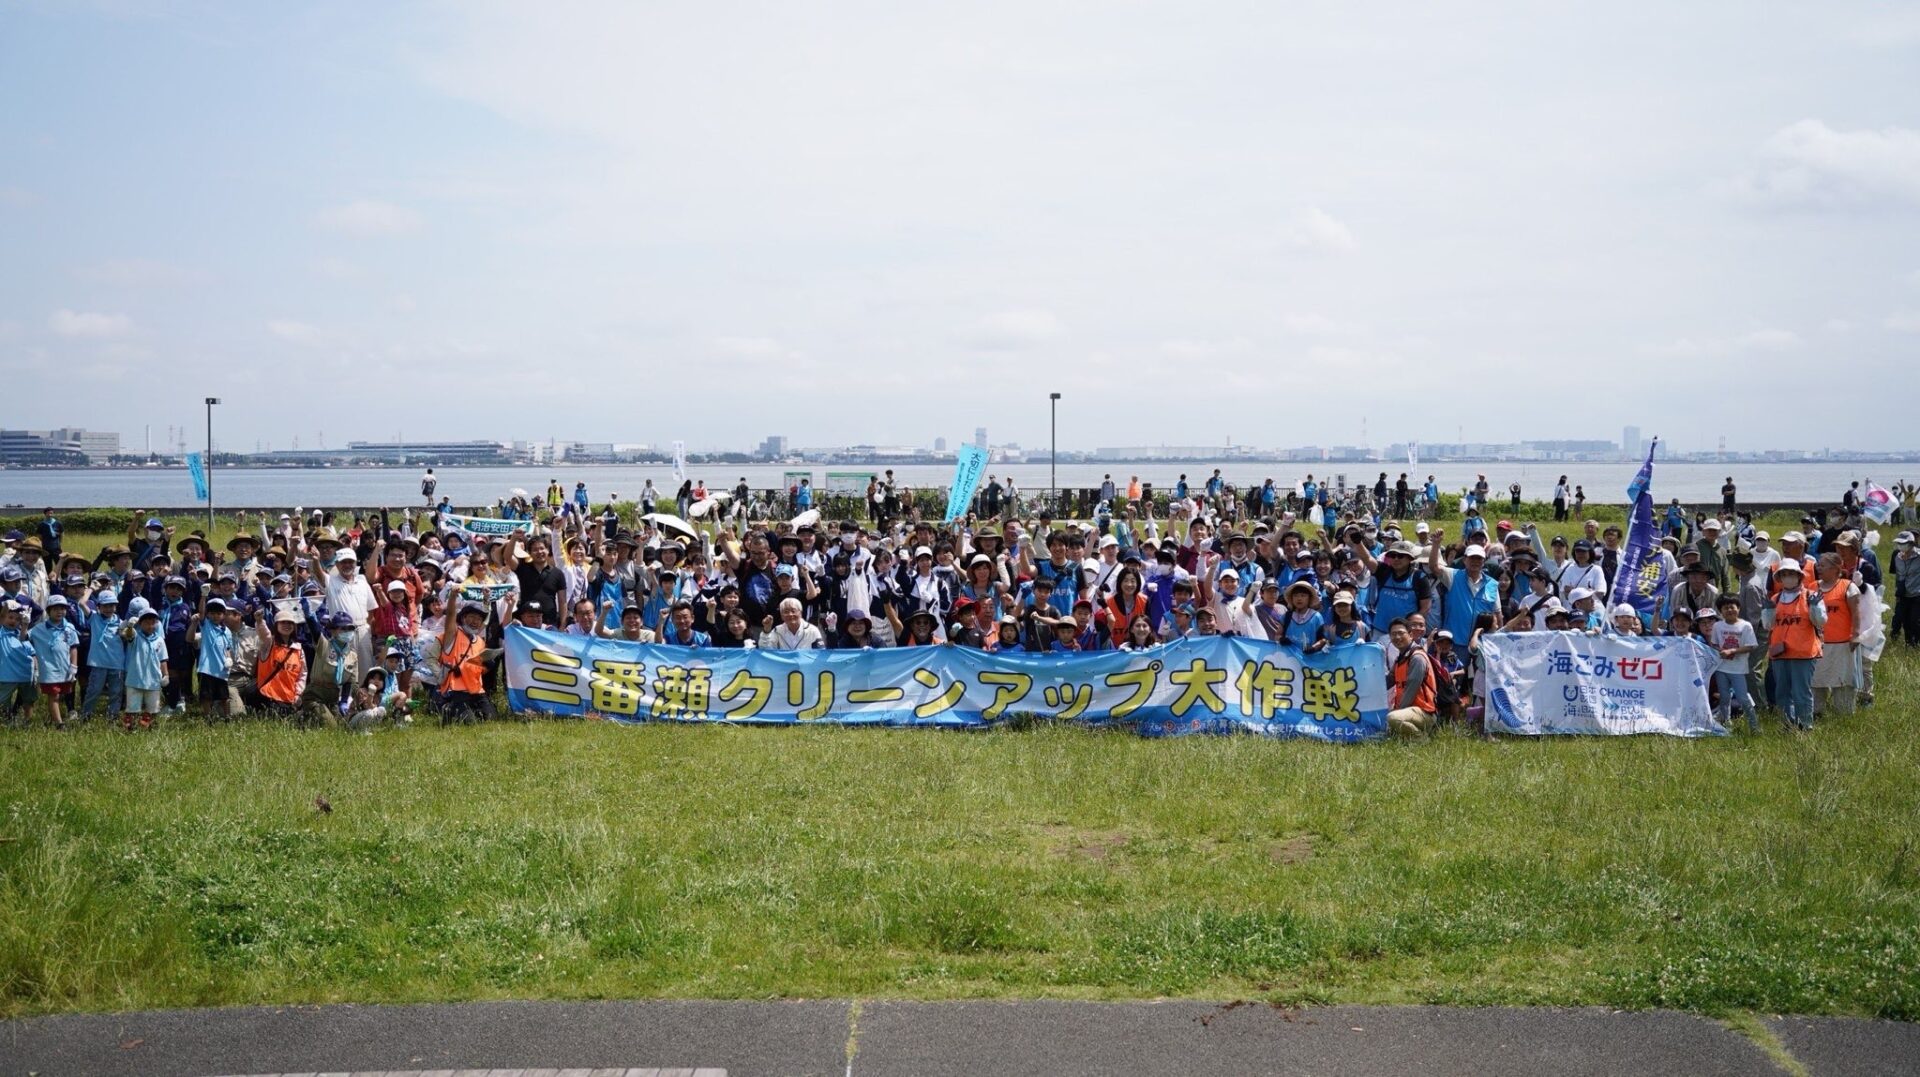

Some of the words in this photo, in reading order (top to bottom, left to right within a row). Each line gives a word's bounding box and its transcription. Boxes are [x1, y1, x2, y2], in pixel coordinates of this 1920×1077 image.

[1775, 616, 1802, 626] TAFF
[1547, 649, 1663, 680] 海ごみゼロ
[525, 648, 1361, 723] 三番瀬クリーンアップ大作戦
[1600, 688, 1645, 699] CHANGE
